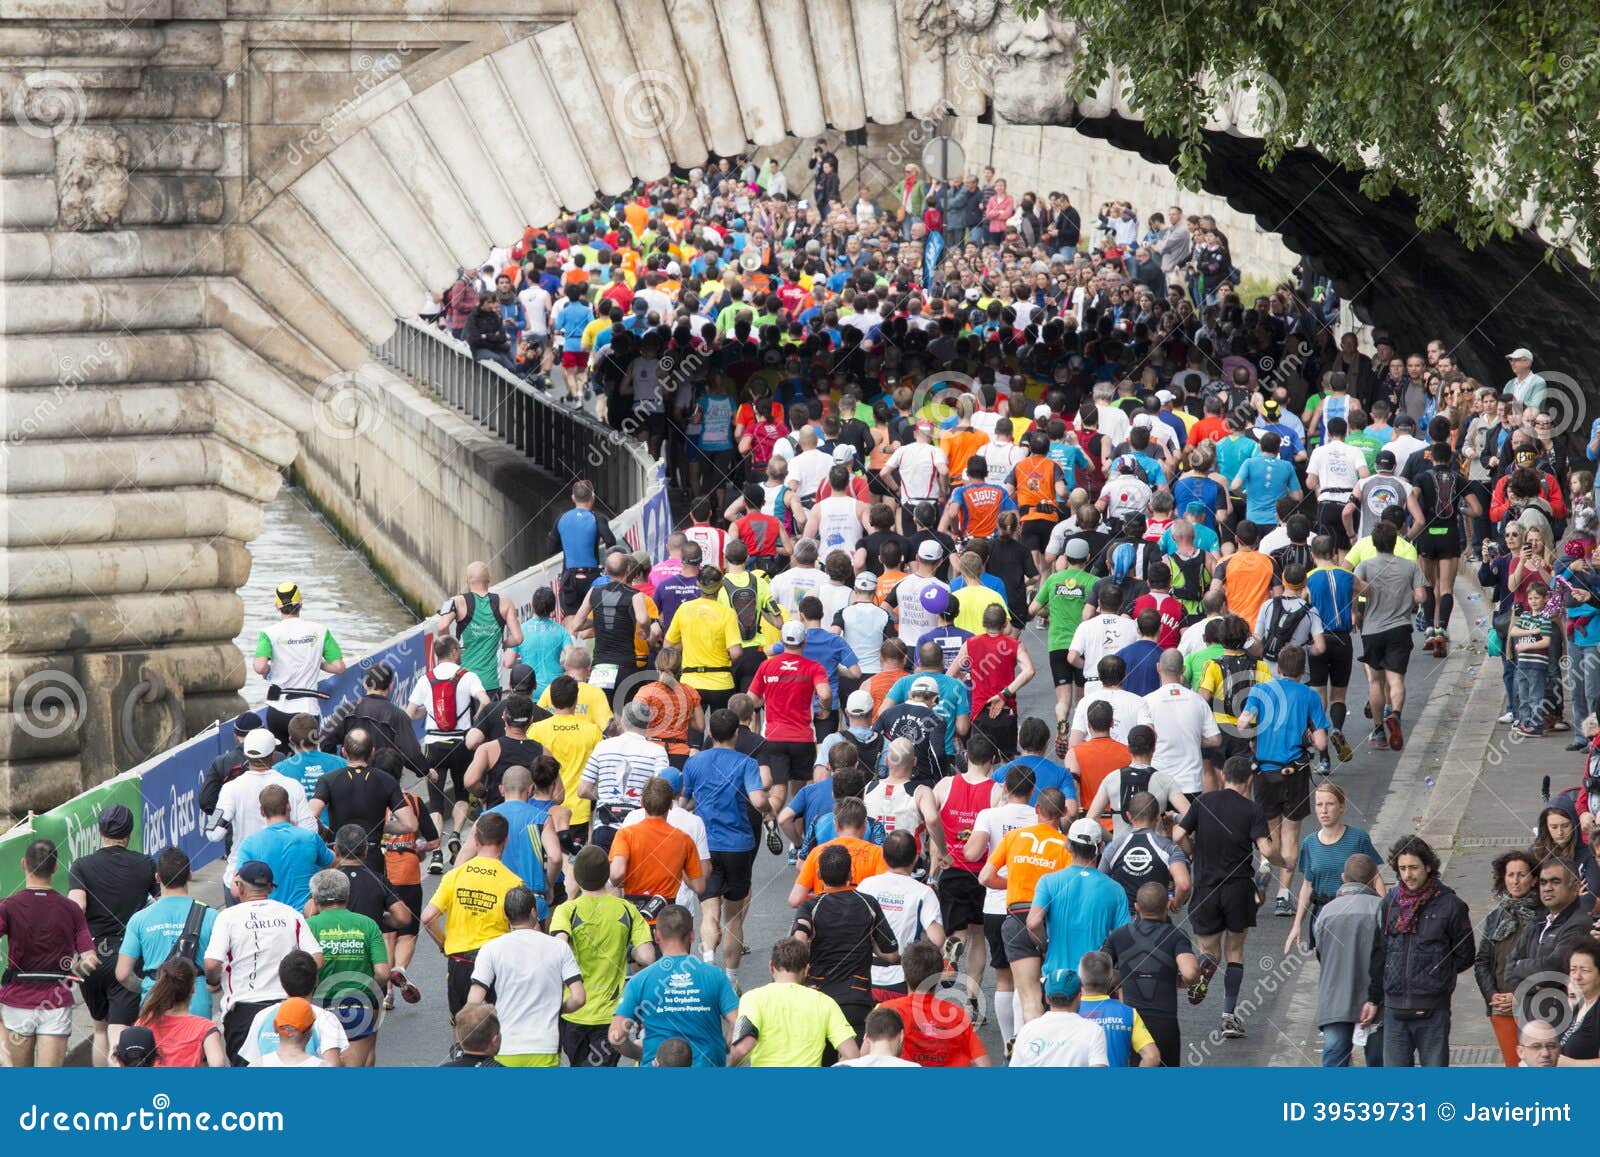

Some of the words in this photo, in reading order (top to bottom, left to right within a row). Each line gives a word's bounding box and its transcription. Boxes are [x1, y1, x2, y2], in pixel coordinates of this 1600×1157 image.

[553, 723, 580, 732] boost
[1014, 855, 1057, 870] randstad
[466, 865, 497, 877] boost
[245, 919, 287, 930] CARLOS
[319, 939, 364, 949] Schneider
